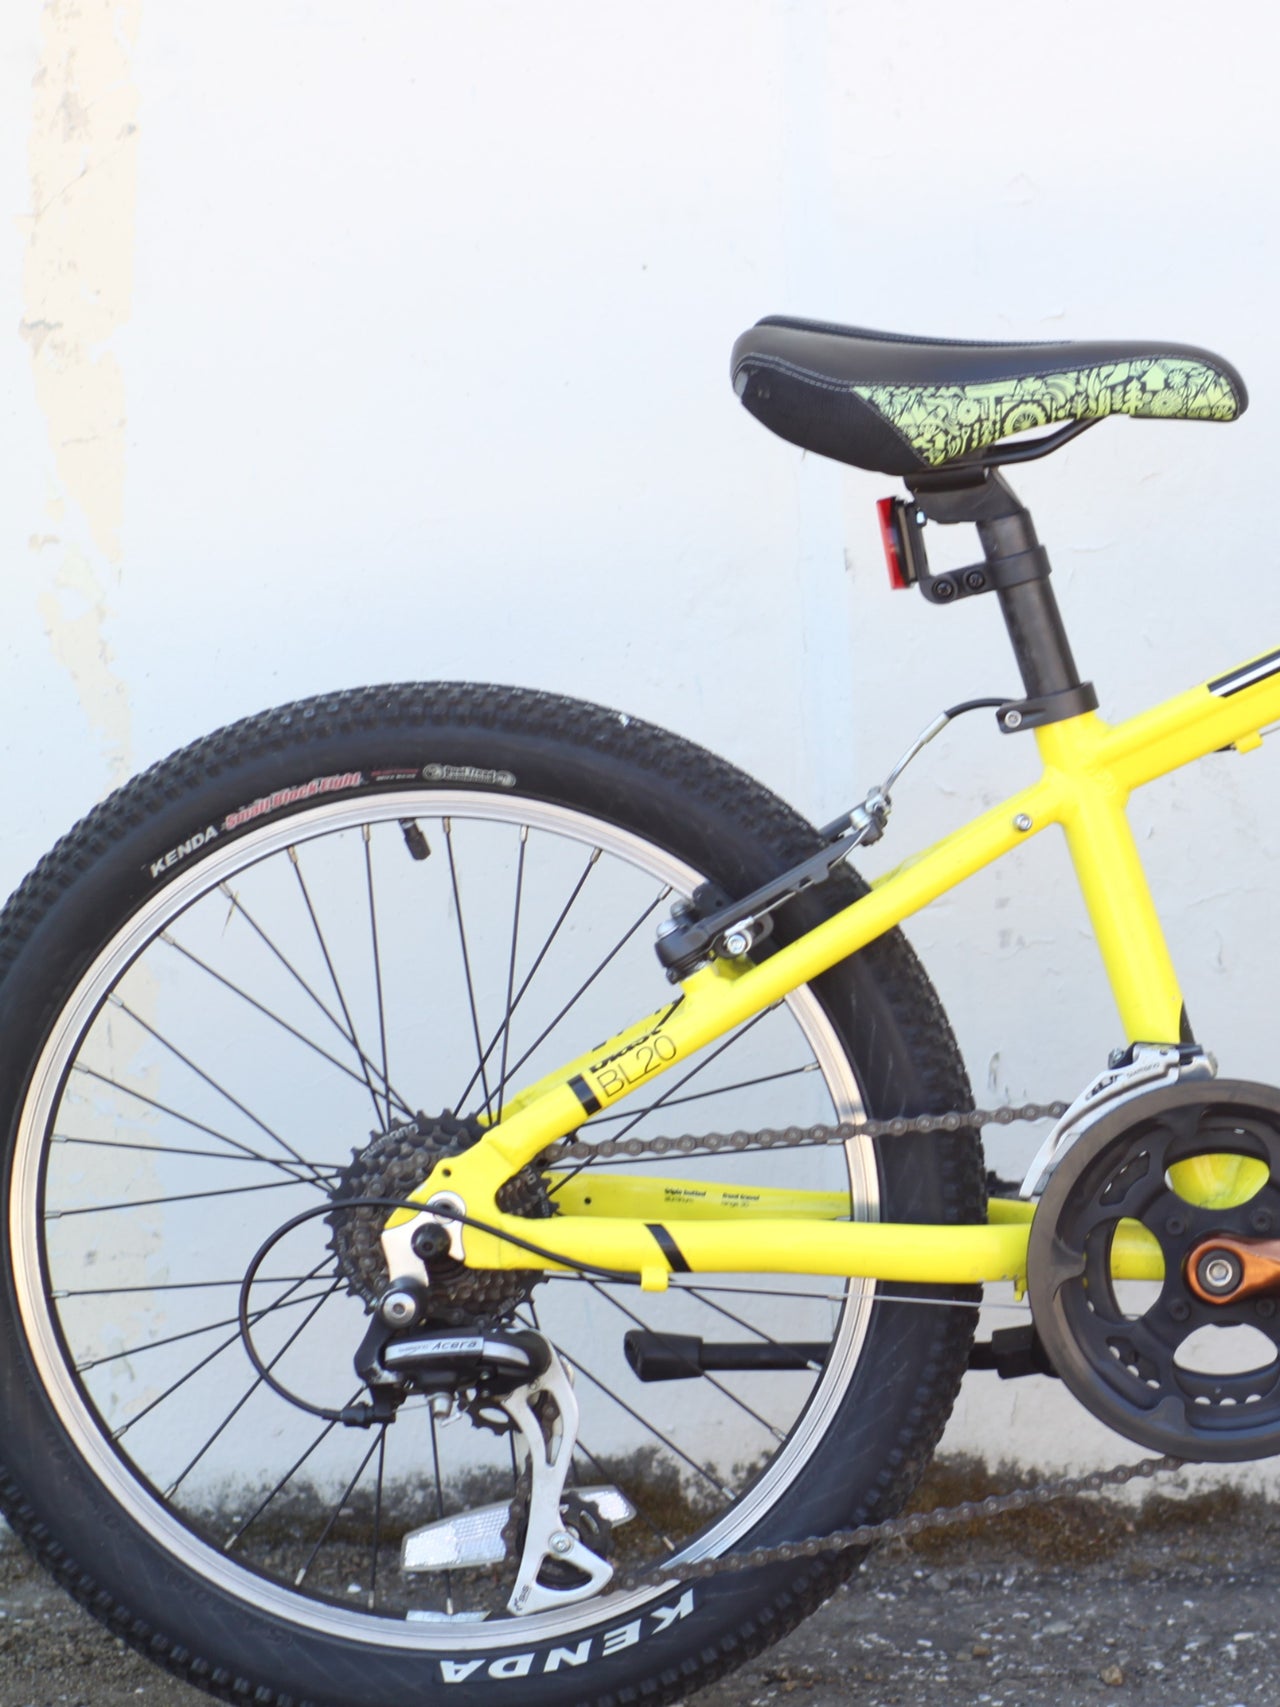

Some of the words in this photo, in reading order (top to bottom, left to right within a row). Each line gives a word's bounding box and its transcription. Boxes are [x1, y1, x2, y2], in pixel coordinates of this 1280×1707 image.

[150, 825, 218, 878] KENDA
[596, 1034, 677, 1098] BL20
[432, 1341, 477, 1352] Acera
[439, 1588, 695, 1683] KENDA
